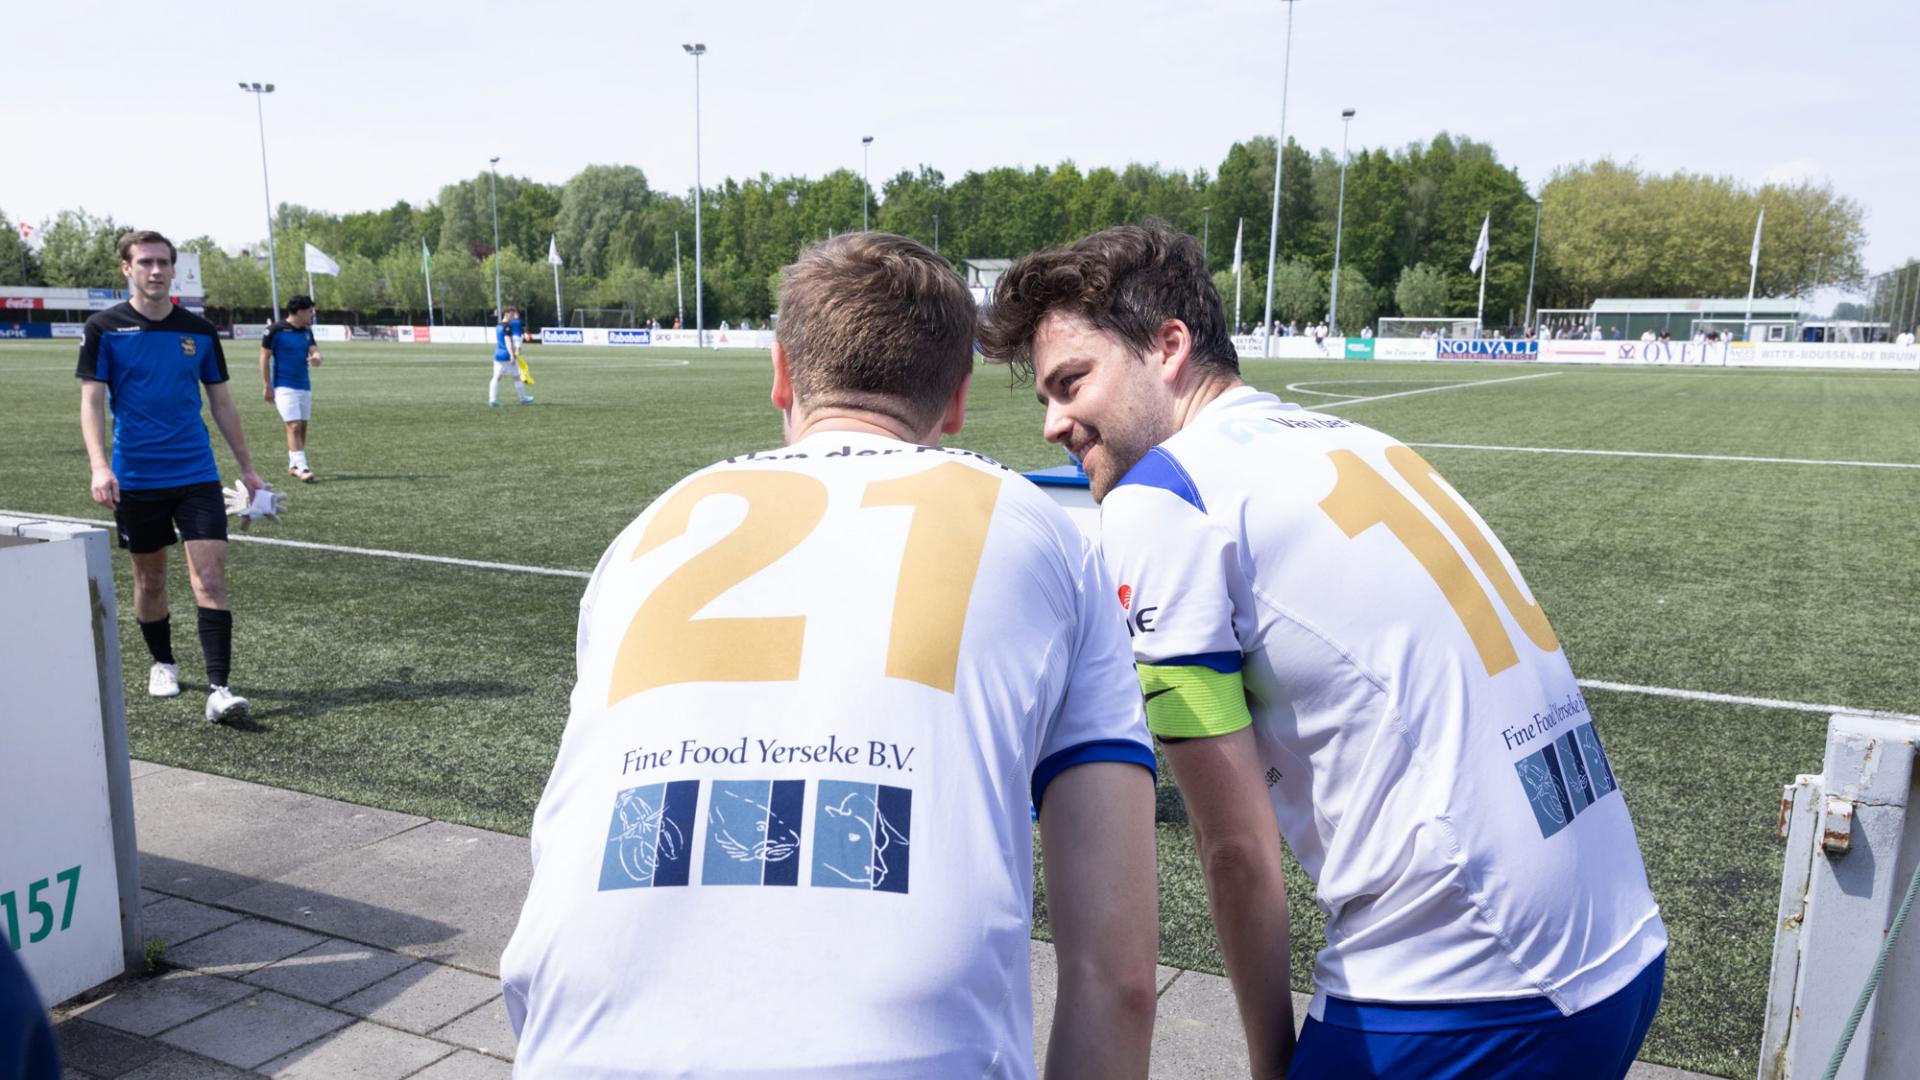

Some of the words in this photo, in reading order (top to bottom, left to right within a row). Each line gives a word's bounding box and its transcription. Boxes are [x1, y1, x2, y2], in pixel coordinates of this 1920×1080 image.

[1440, 341, 1537, 354] NOUVALL
[607, 460, 1003, 708] 21
[1317, 445, 1561, 678] 10
[622, 746, 672, 775] Fine
[680, 737, 748, 765] Food
[757, 735, 859, 764] Yerseke
[868, 740, 915, 772] B.V.
[1501, 723, 1537, 751] Fine
[0, 864, 81, 952] 157
